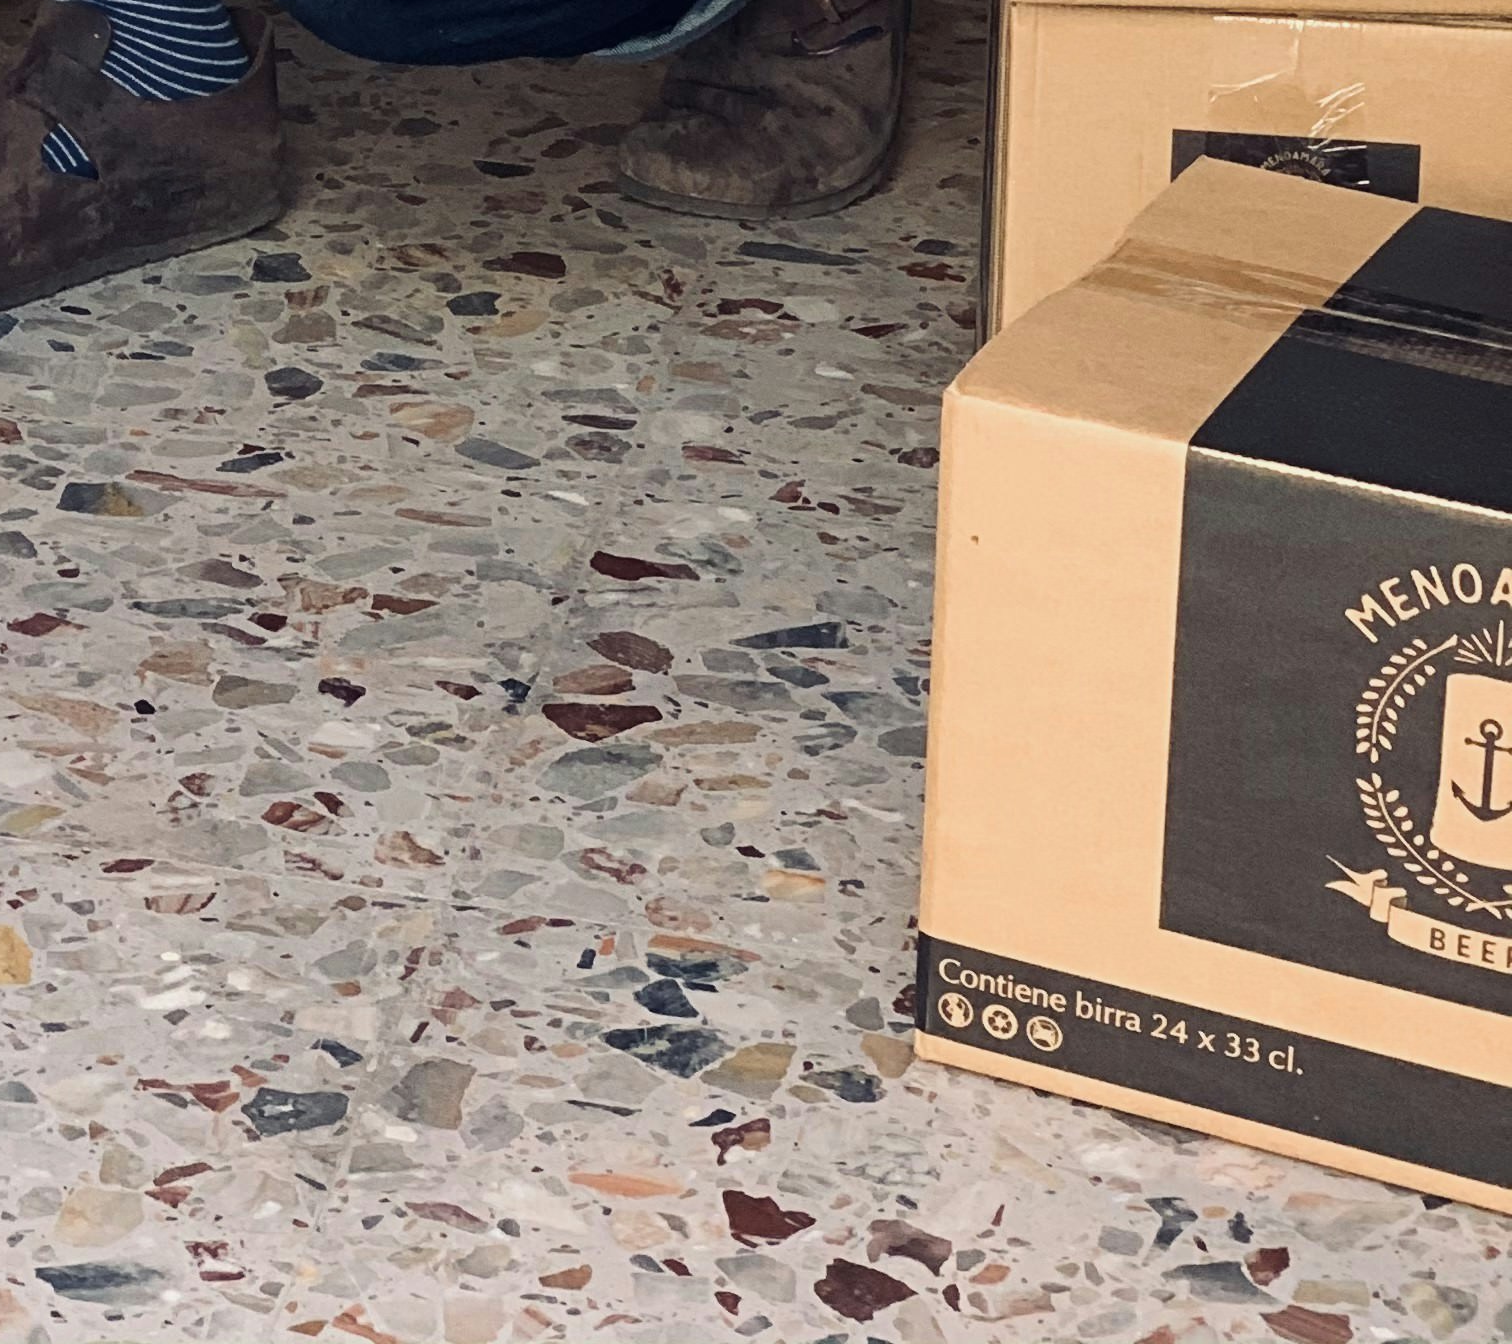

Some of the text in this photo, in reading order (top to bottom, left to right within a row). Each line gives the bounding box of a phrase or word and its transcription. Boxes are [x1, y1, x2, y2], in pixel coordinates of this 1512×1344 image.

[938, 958, 1304, 1076] Contiene birra 24 x 33 cl.
